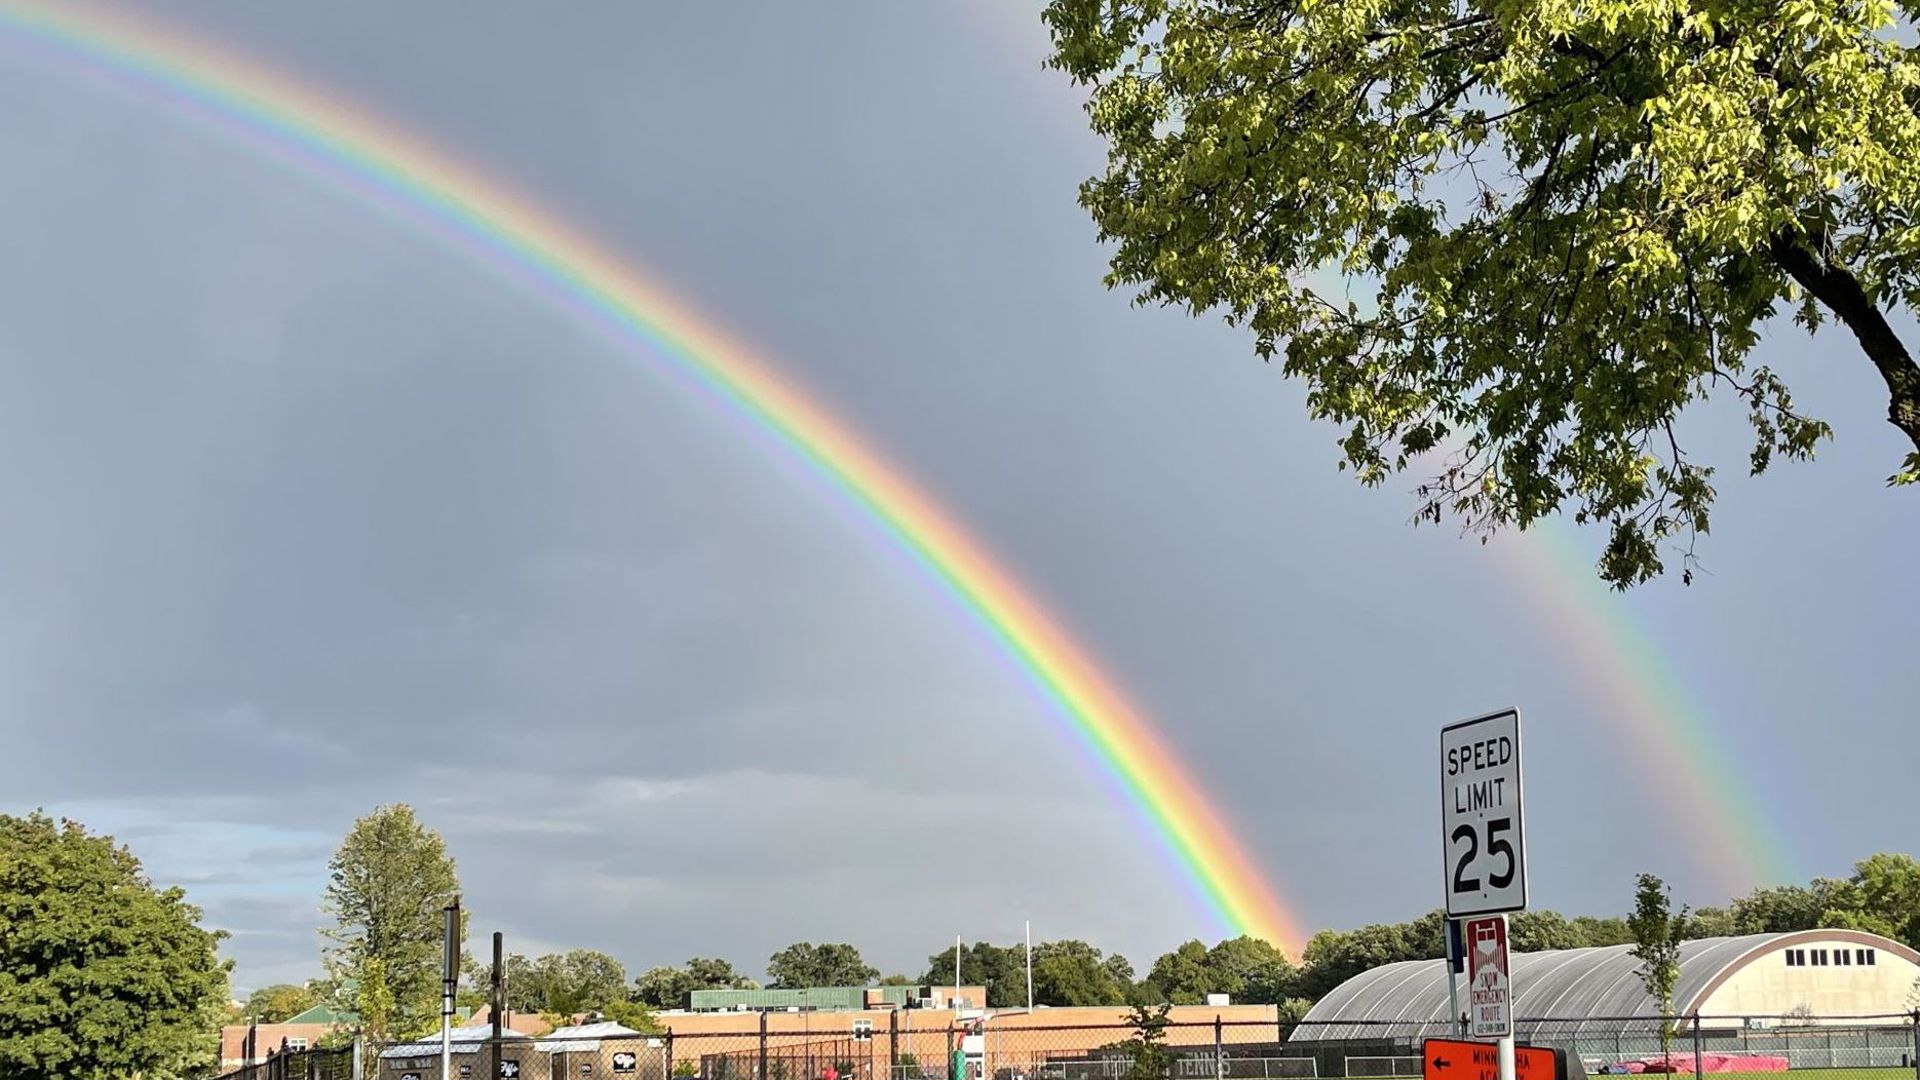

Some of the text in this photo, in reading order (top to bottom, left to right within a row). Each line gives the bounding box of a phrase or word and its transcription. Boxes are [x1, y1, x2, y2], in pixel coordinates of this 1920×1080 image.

[1448, 736, 1511, 776] SPEED
[1455, 777, 1505, 814] LIMIT
[1451, 817, 1515, 893] 25
[1480, 971, 1498, 987] SNOW
[1473, 988, 1506, 1005] EMERGENCY
[1481, 1005, 1500, 1021] ROUTE
[1176, 1051, 1231, 1076] TENNS
[1473, 1050, 1530, 1070] MINNHA
[1480, 1070, 1525, 1080] ACAY
